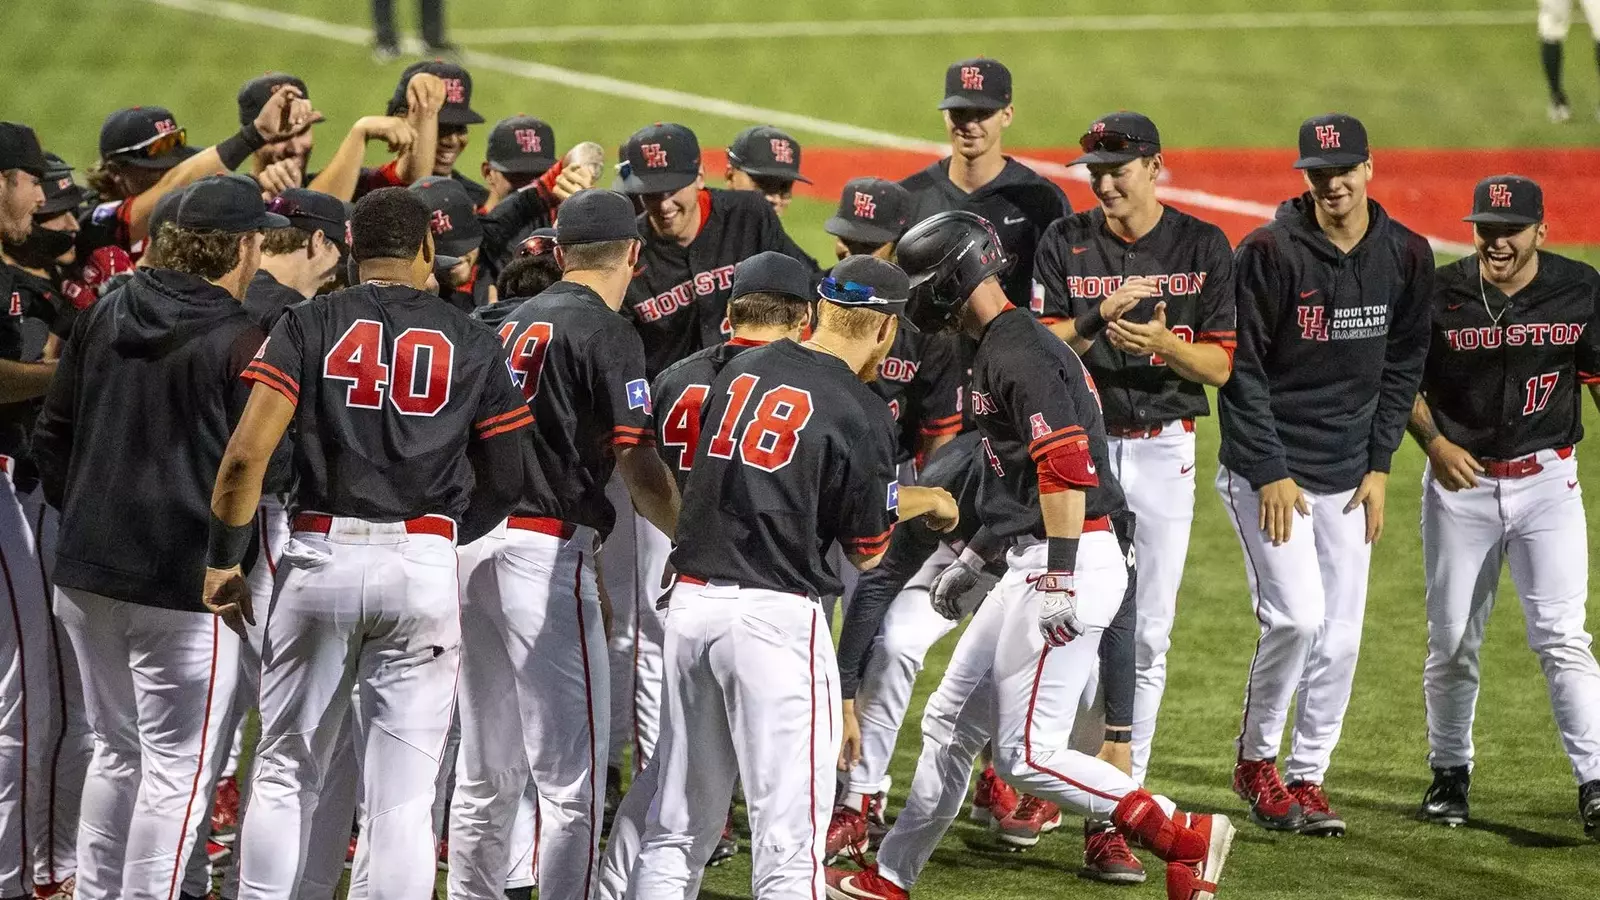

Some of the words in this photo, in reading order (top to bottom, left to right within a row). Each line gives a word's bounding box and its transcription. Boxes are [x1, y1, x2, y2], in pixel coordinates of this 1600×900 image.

[1315, 125, 1340, 149] UH
[640, 143, 668, 168] UH
[1489, 184, 1512, 207] UH
[633, 264, 735, 323] HOUST
[1066, 271, 1208, 299] HOUTON
[1297, 306, 1331, 341] UH
[1333, 315, 1386, 329] COUGARS
[1334, 304, 1388, 318] HOUTON
[323, 319, 455, 417] 40
[1522, 371, 1560, 416] 17
[708, 373, 814, 473] 18
